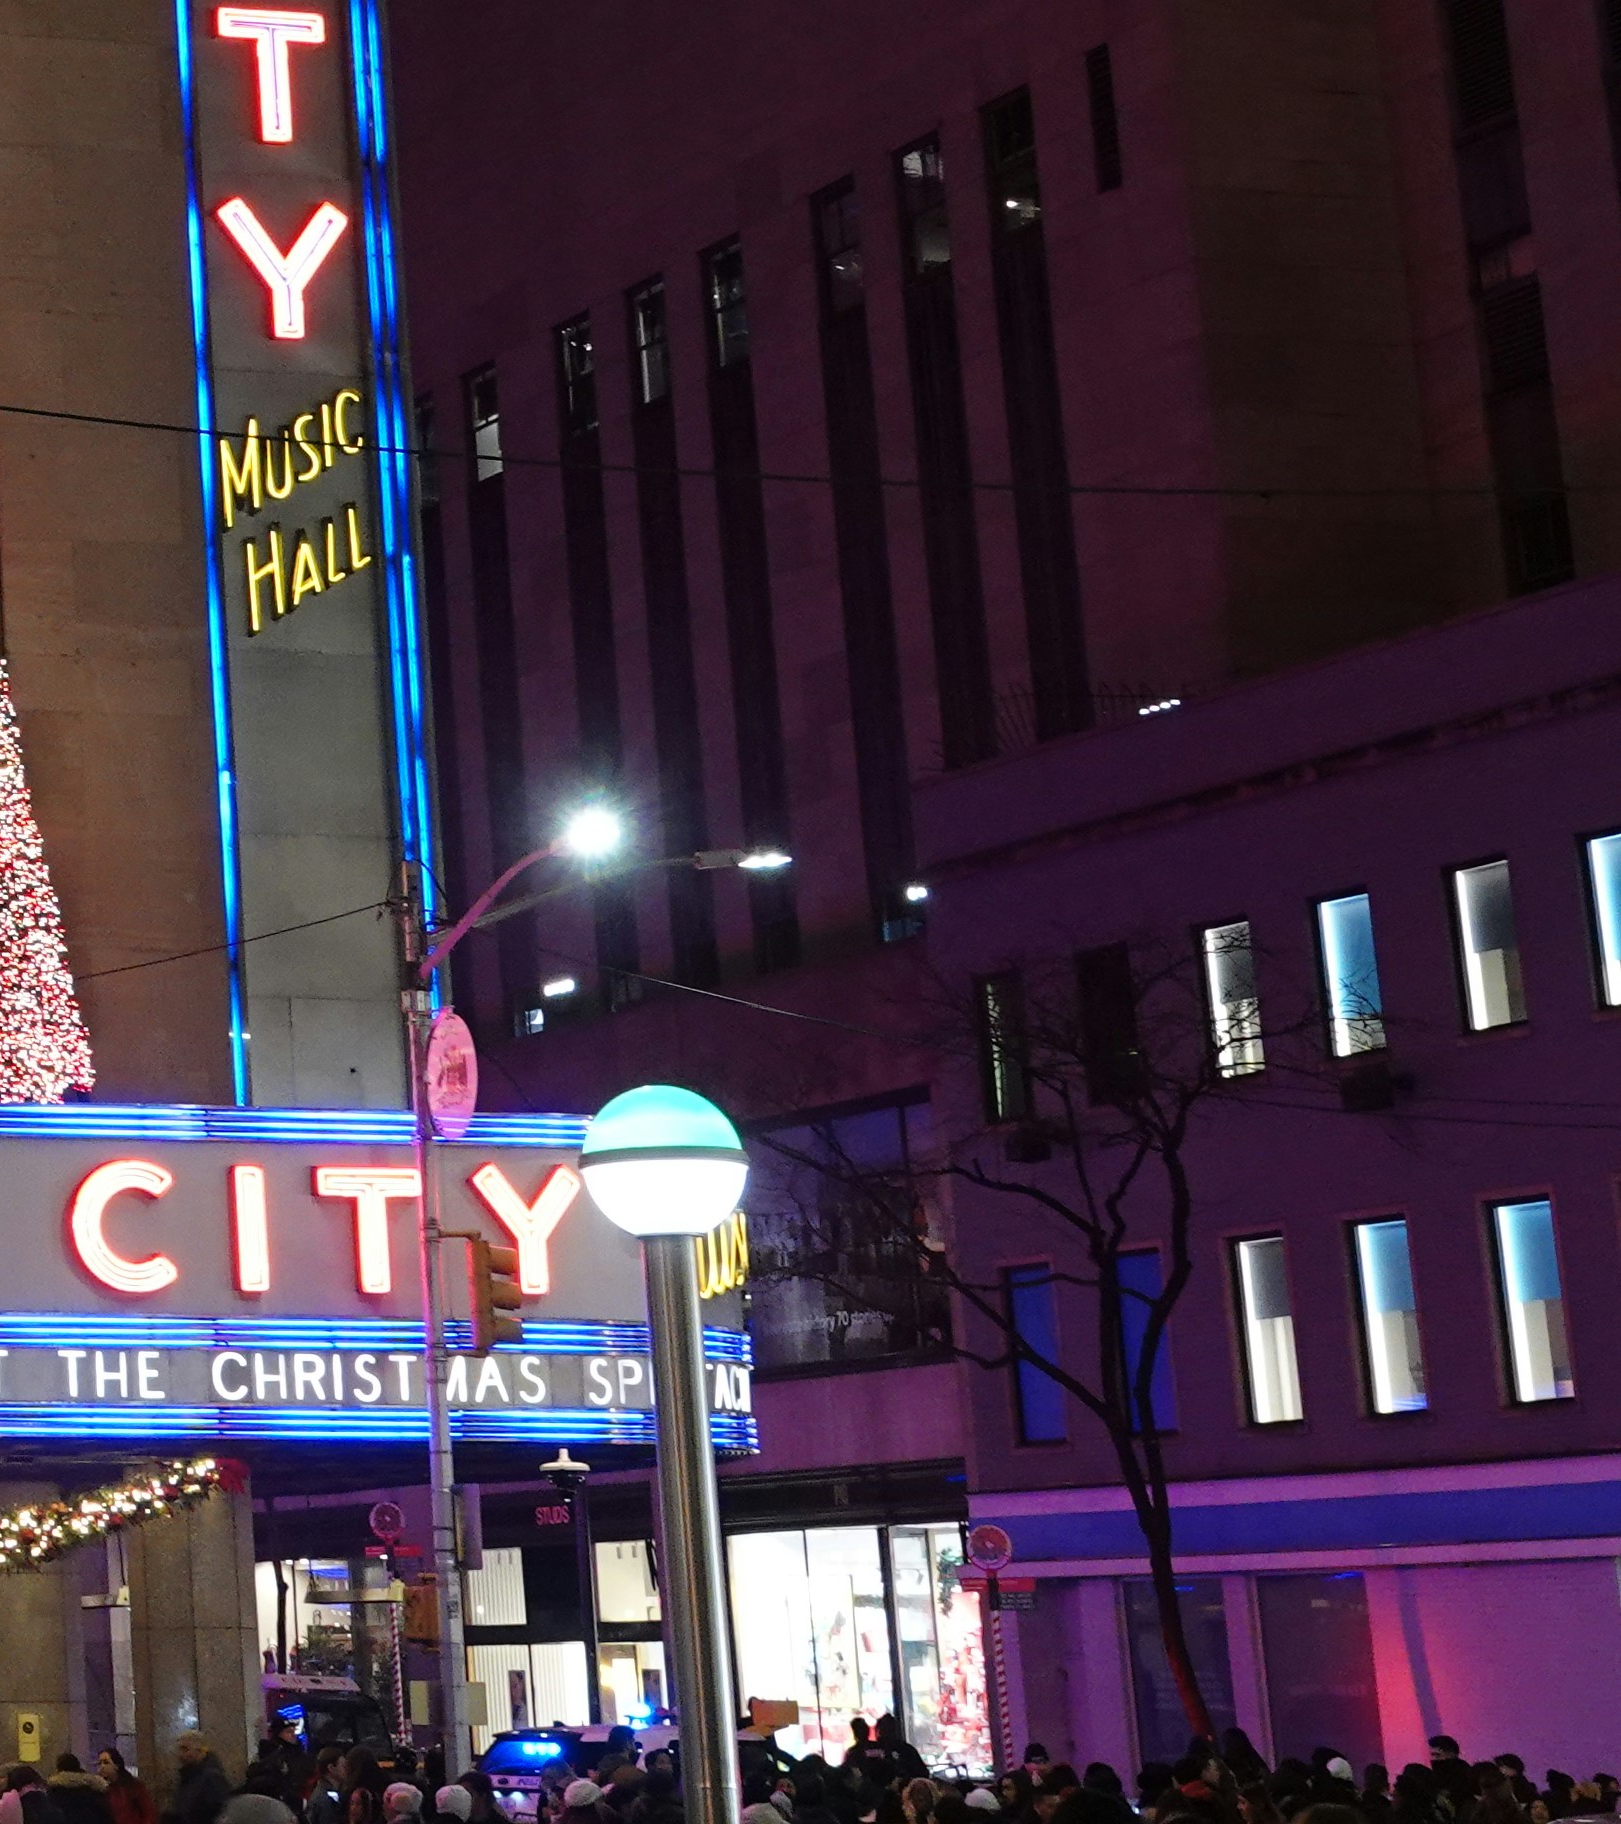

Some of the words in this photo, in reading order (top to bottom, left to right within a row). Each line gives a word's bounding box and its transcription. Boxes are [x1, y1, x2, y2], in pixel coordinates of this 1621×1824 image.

[218, 389, 363, 528] MUSIC
[244, 506, 372, 633] HALL
[69, 1158, 581, 1297] CITY
[58, 1350, 166, 1401] THE
[535, 1505, 570, 1526] STUDS
